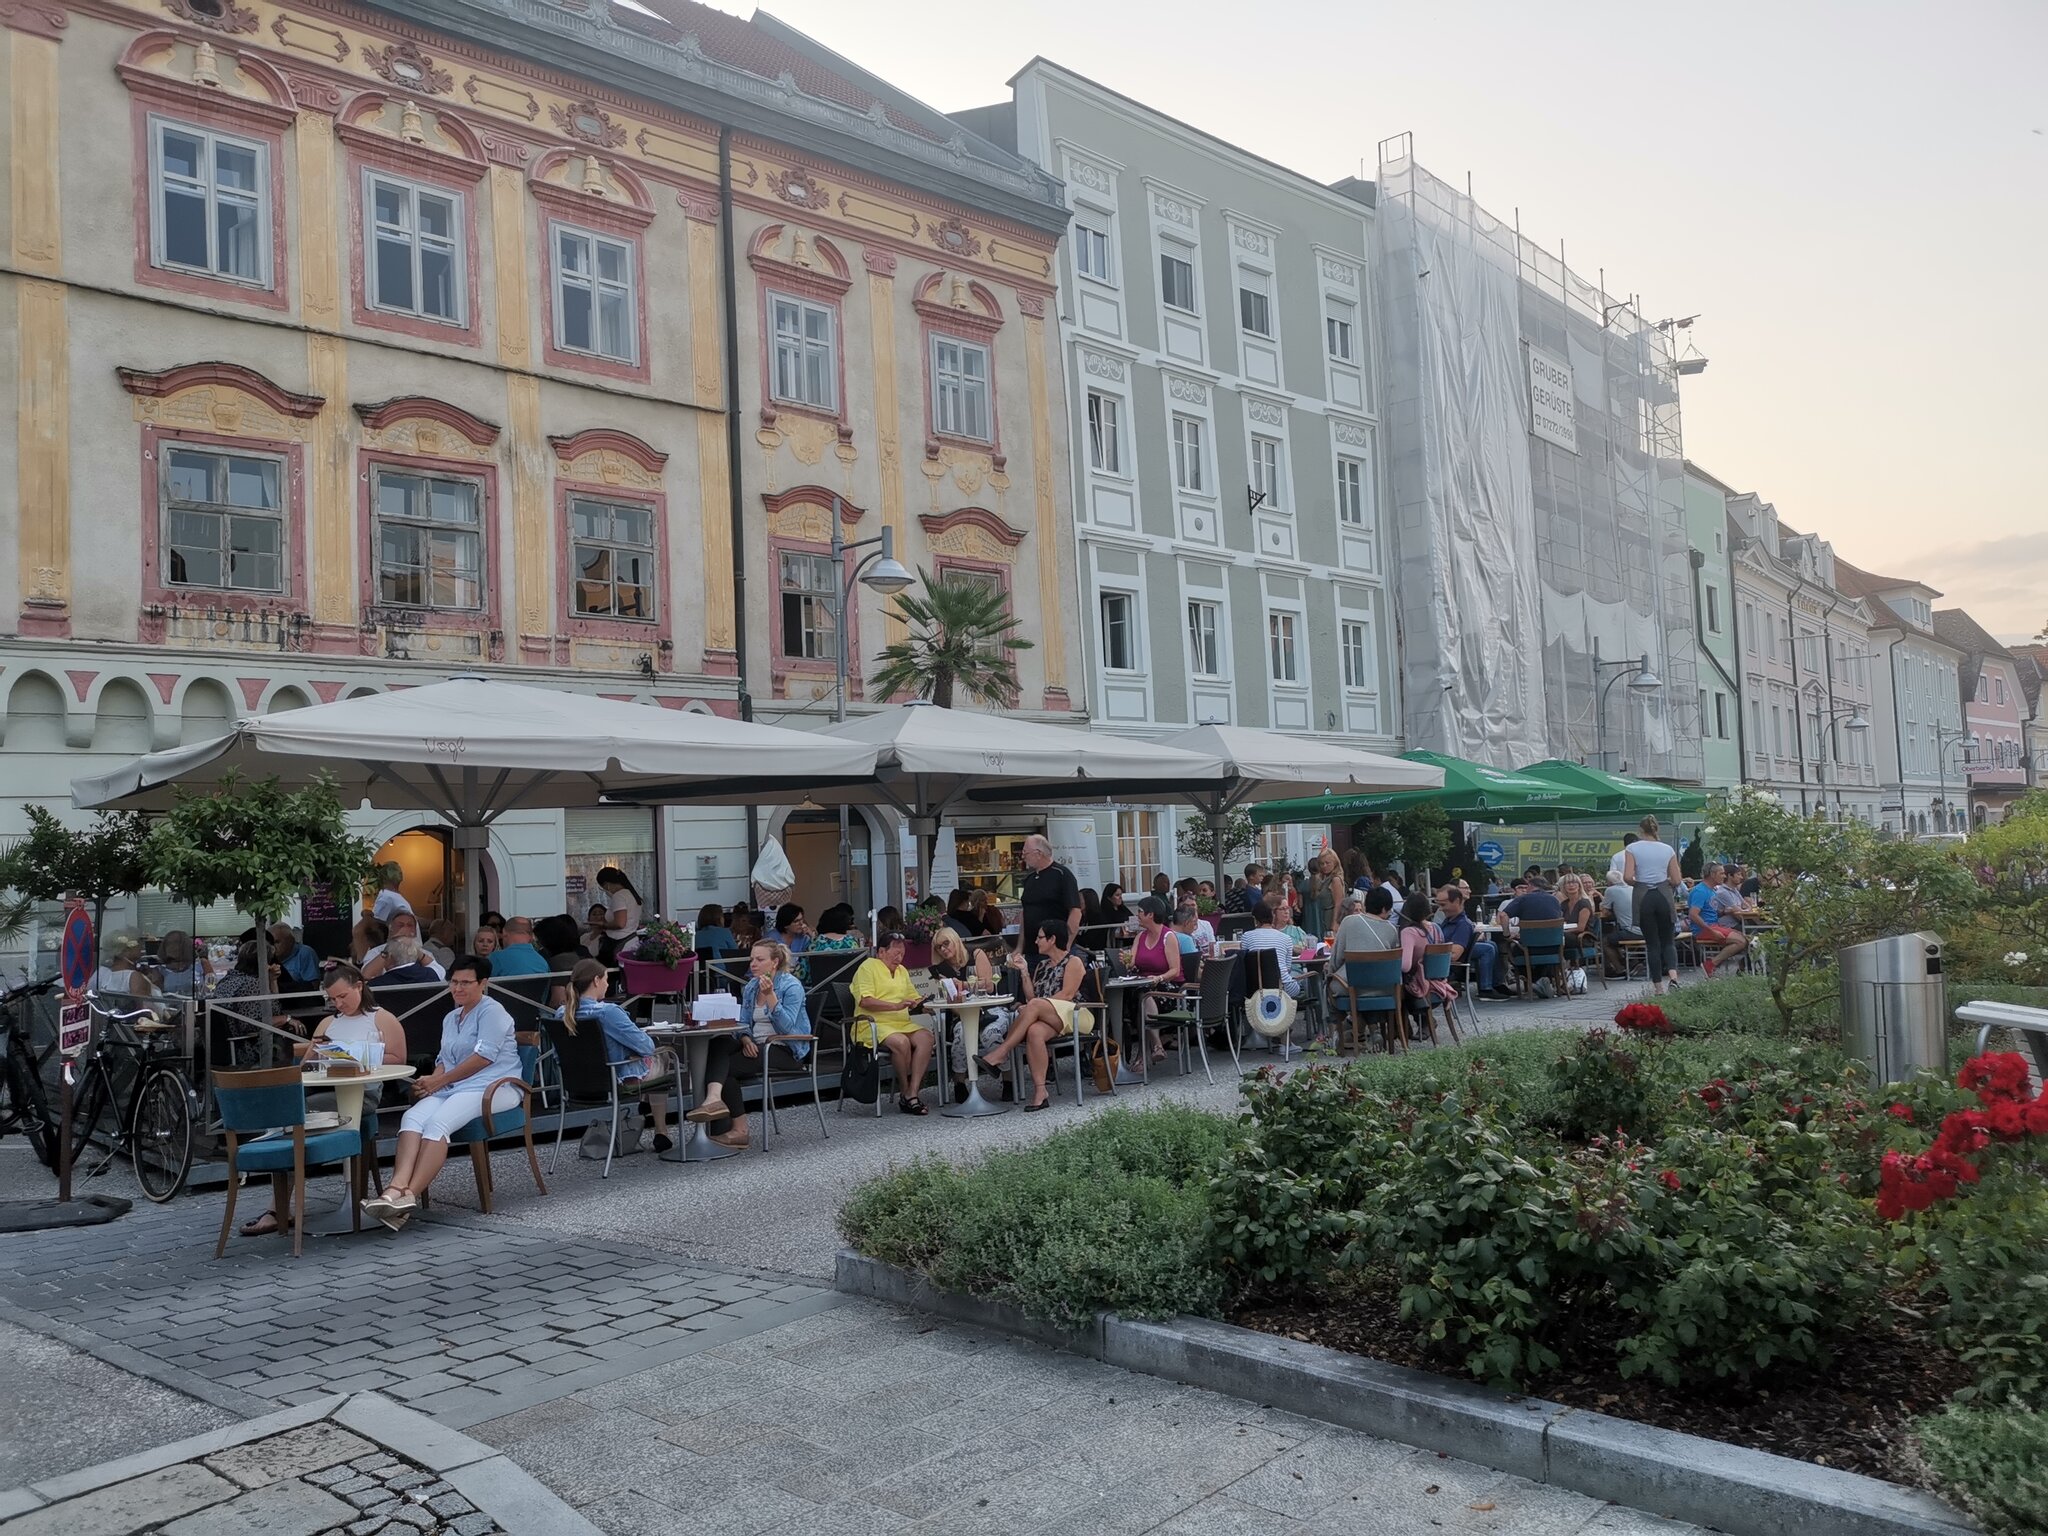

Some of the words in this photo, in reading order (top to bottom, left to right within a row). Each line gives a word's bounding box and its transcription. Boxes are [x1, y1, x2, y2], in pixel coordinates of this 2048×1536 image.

[1532, 357, 1569, 391] GRUBER
[1532, 385, 1573, 418] GERÜSTE
[1562, 842, 1610, 854] KERN
